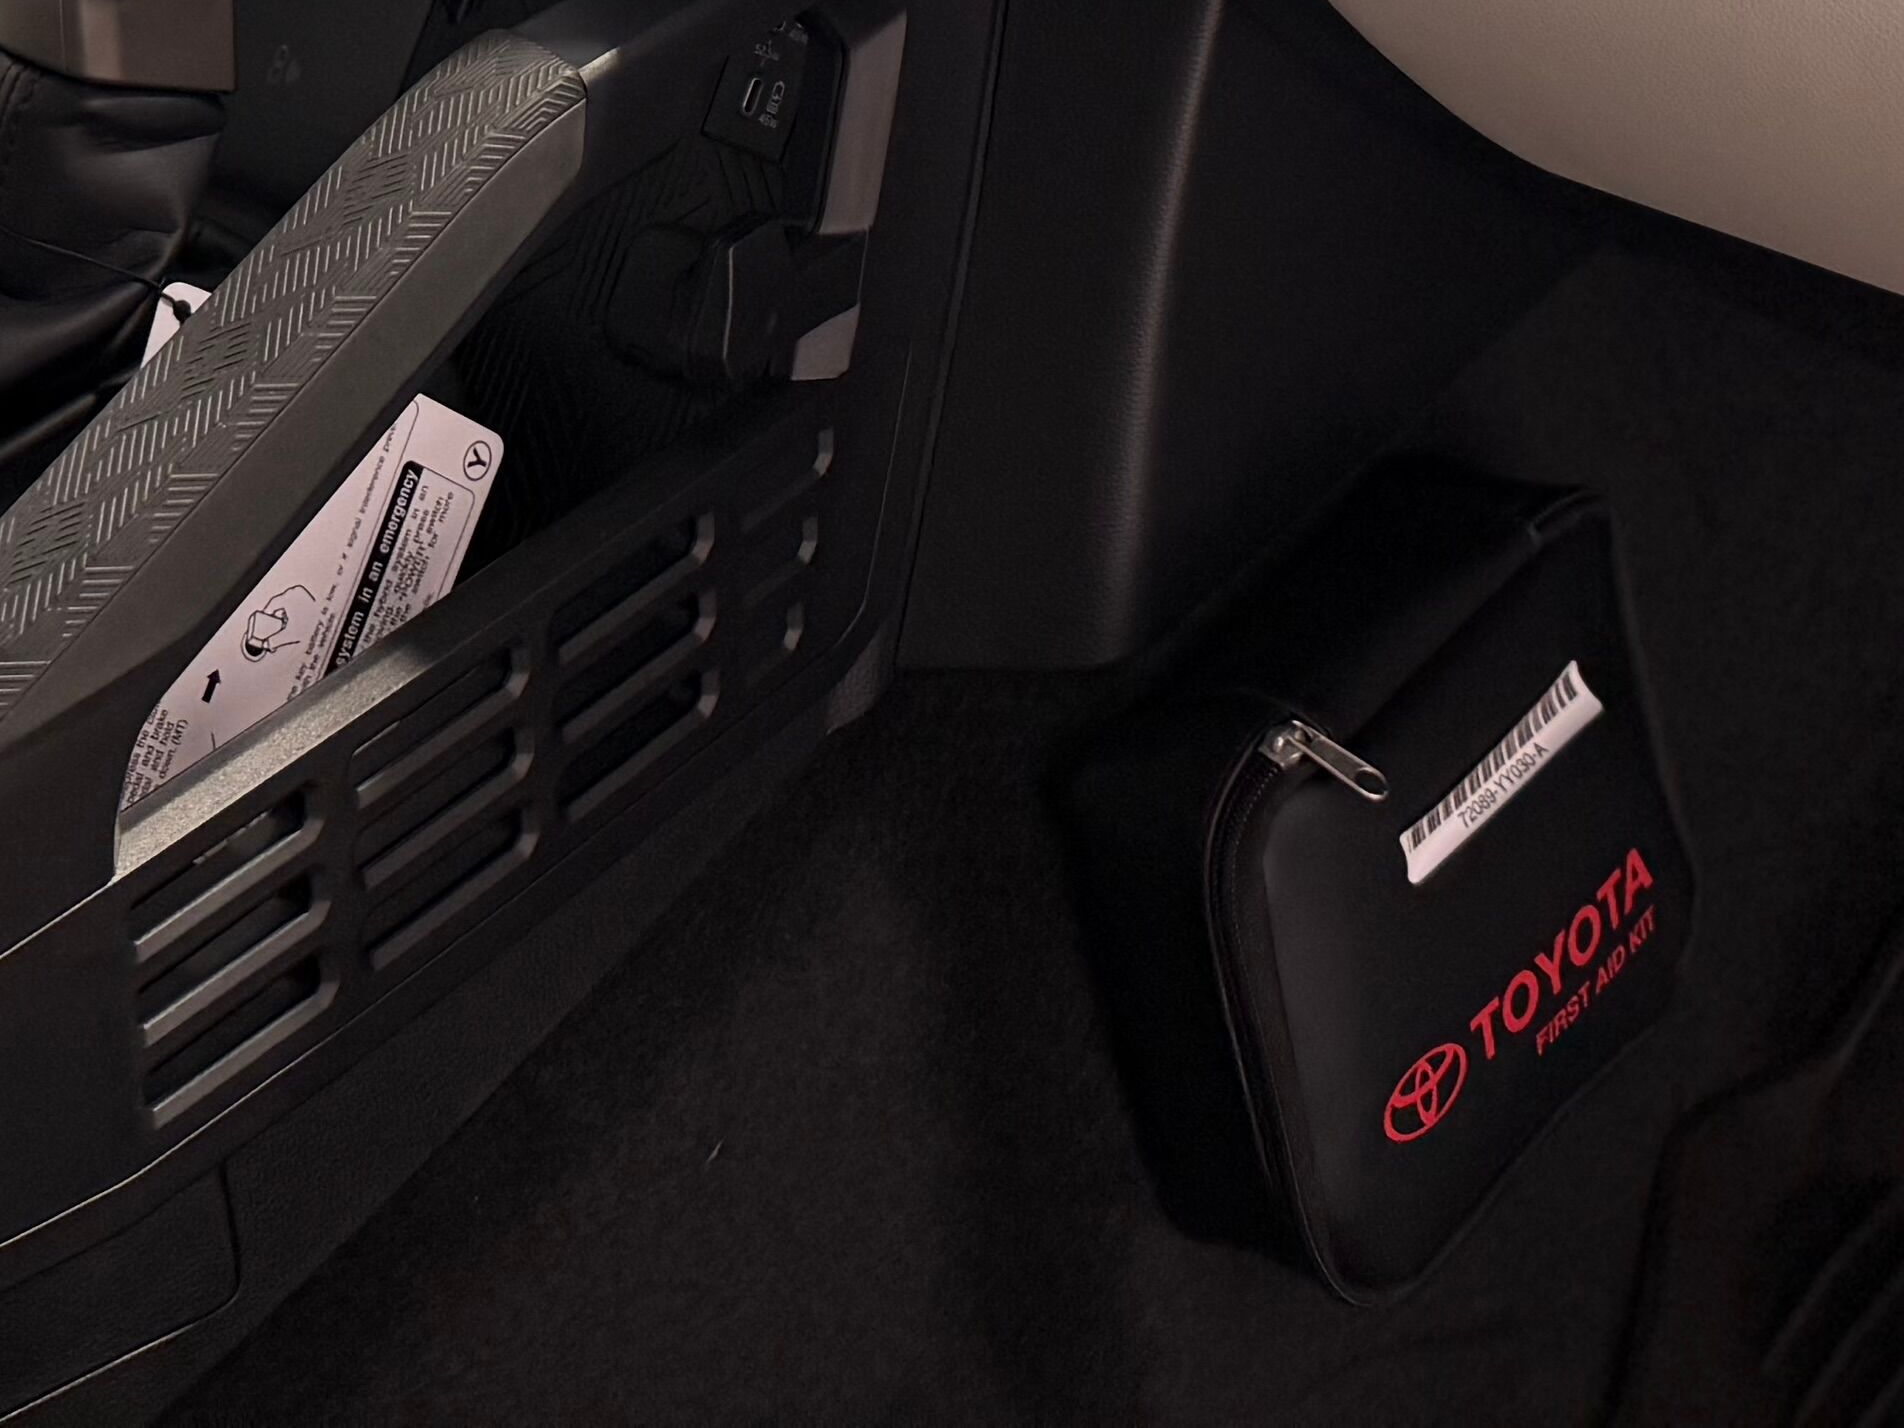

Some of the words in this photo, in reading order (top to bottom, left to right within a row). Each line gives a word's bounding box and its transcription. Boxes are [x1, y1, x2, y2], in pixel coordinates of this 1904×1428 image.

[467, 447, 487, 468] Y
[336, 610, 366, 665] system
[358, 585, 374, 604] in
[368, 560, 385, 582] an
[380, 469, 419, 555] emergency
[1469, 847, 1654, 1060] TOYOTA
[1535, 981, 1592, 1056] FIRST
[1595, 945, 1626, 994] AID
[1629, 904, 1656, 953] KIT
